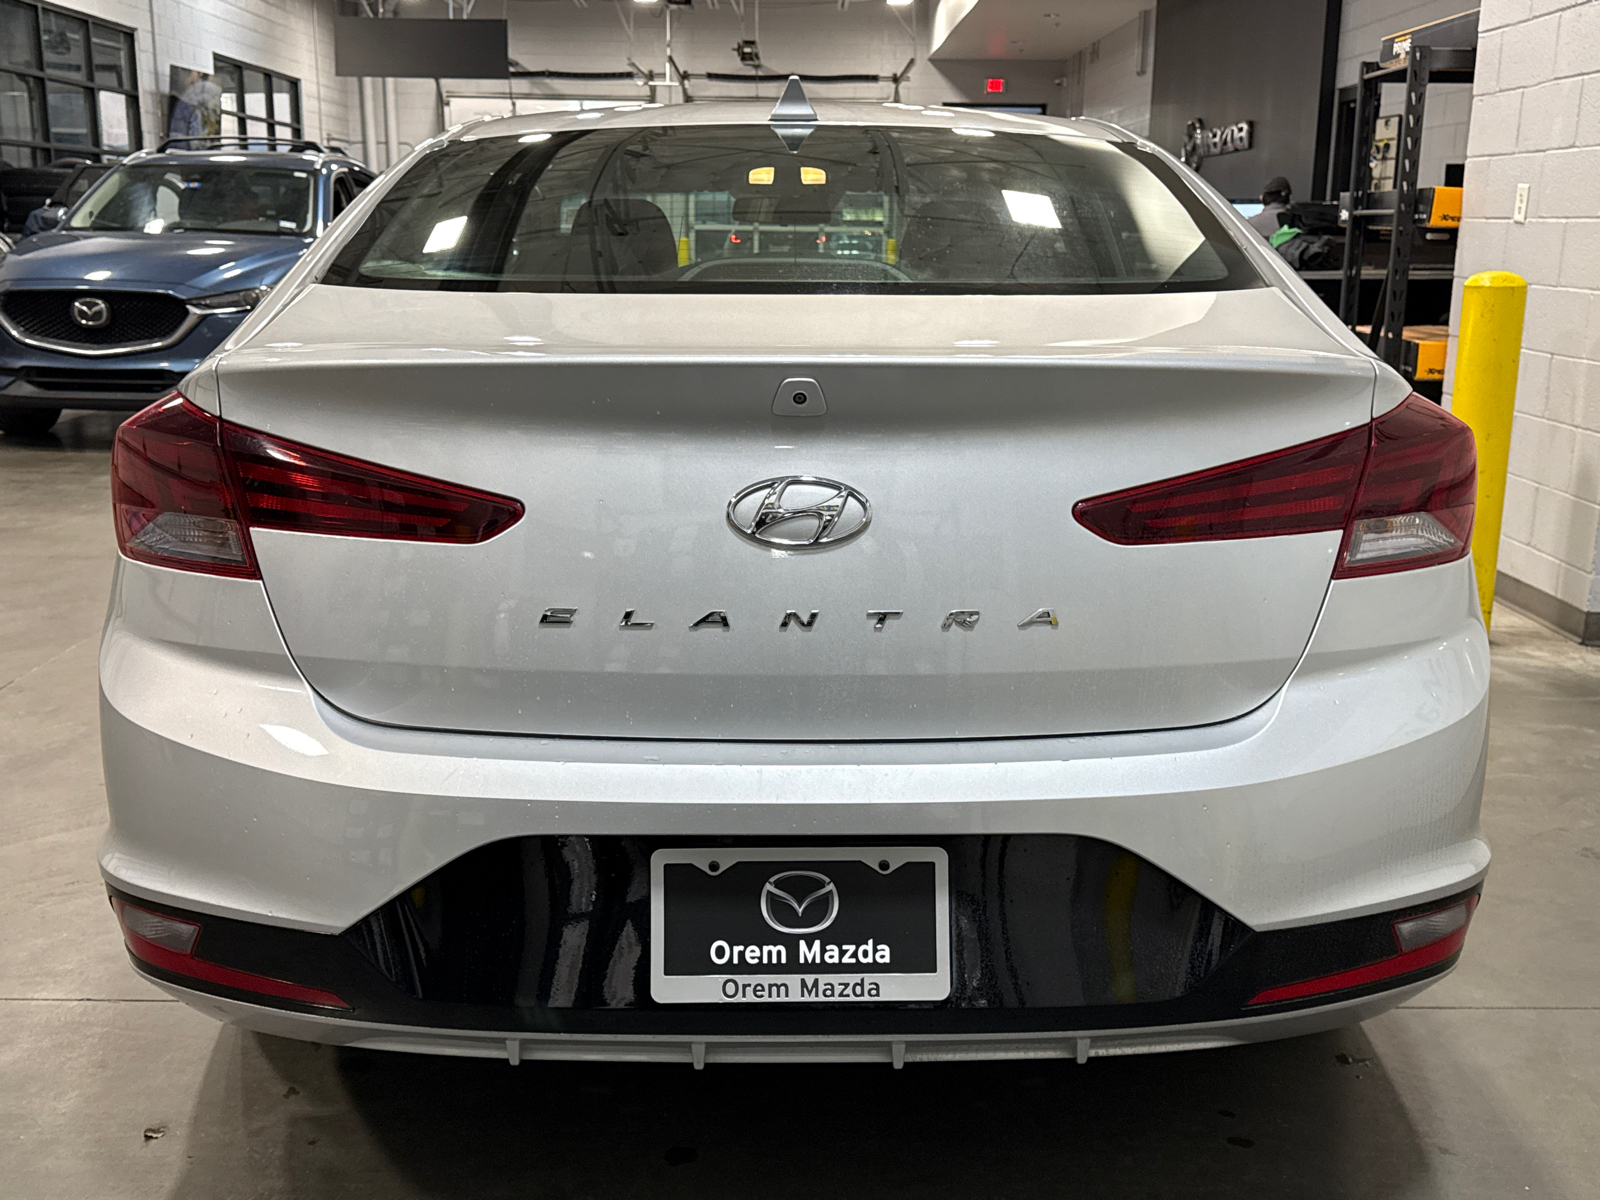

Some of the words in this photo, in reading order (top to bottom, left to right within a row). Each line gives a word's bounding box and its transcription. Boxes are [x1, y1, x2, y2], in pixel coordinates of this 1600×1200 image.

[538, 606, 1060, 631] ELANTRA
[709, 939, 787, 965] Orem
[799, 938, 891, 964] Mazda
[721, 978, 790, 1000] Orem
[800, 977, 881, 999] Mazda
